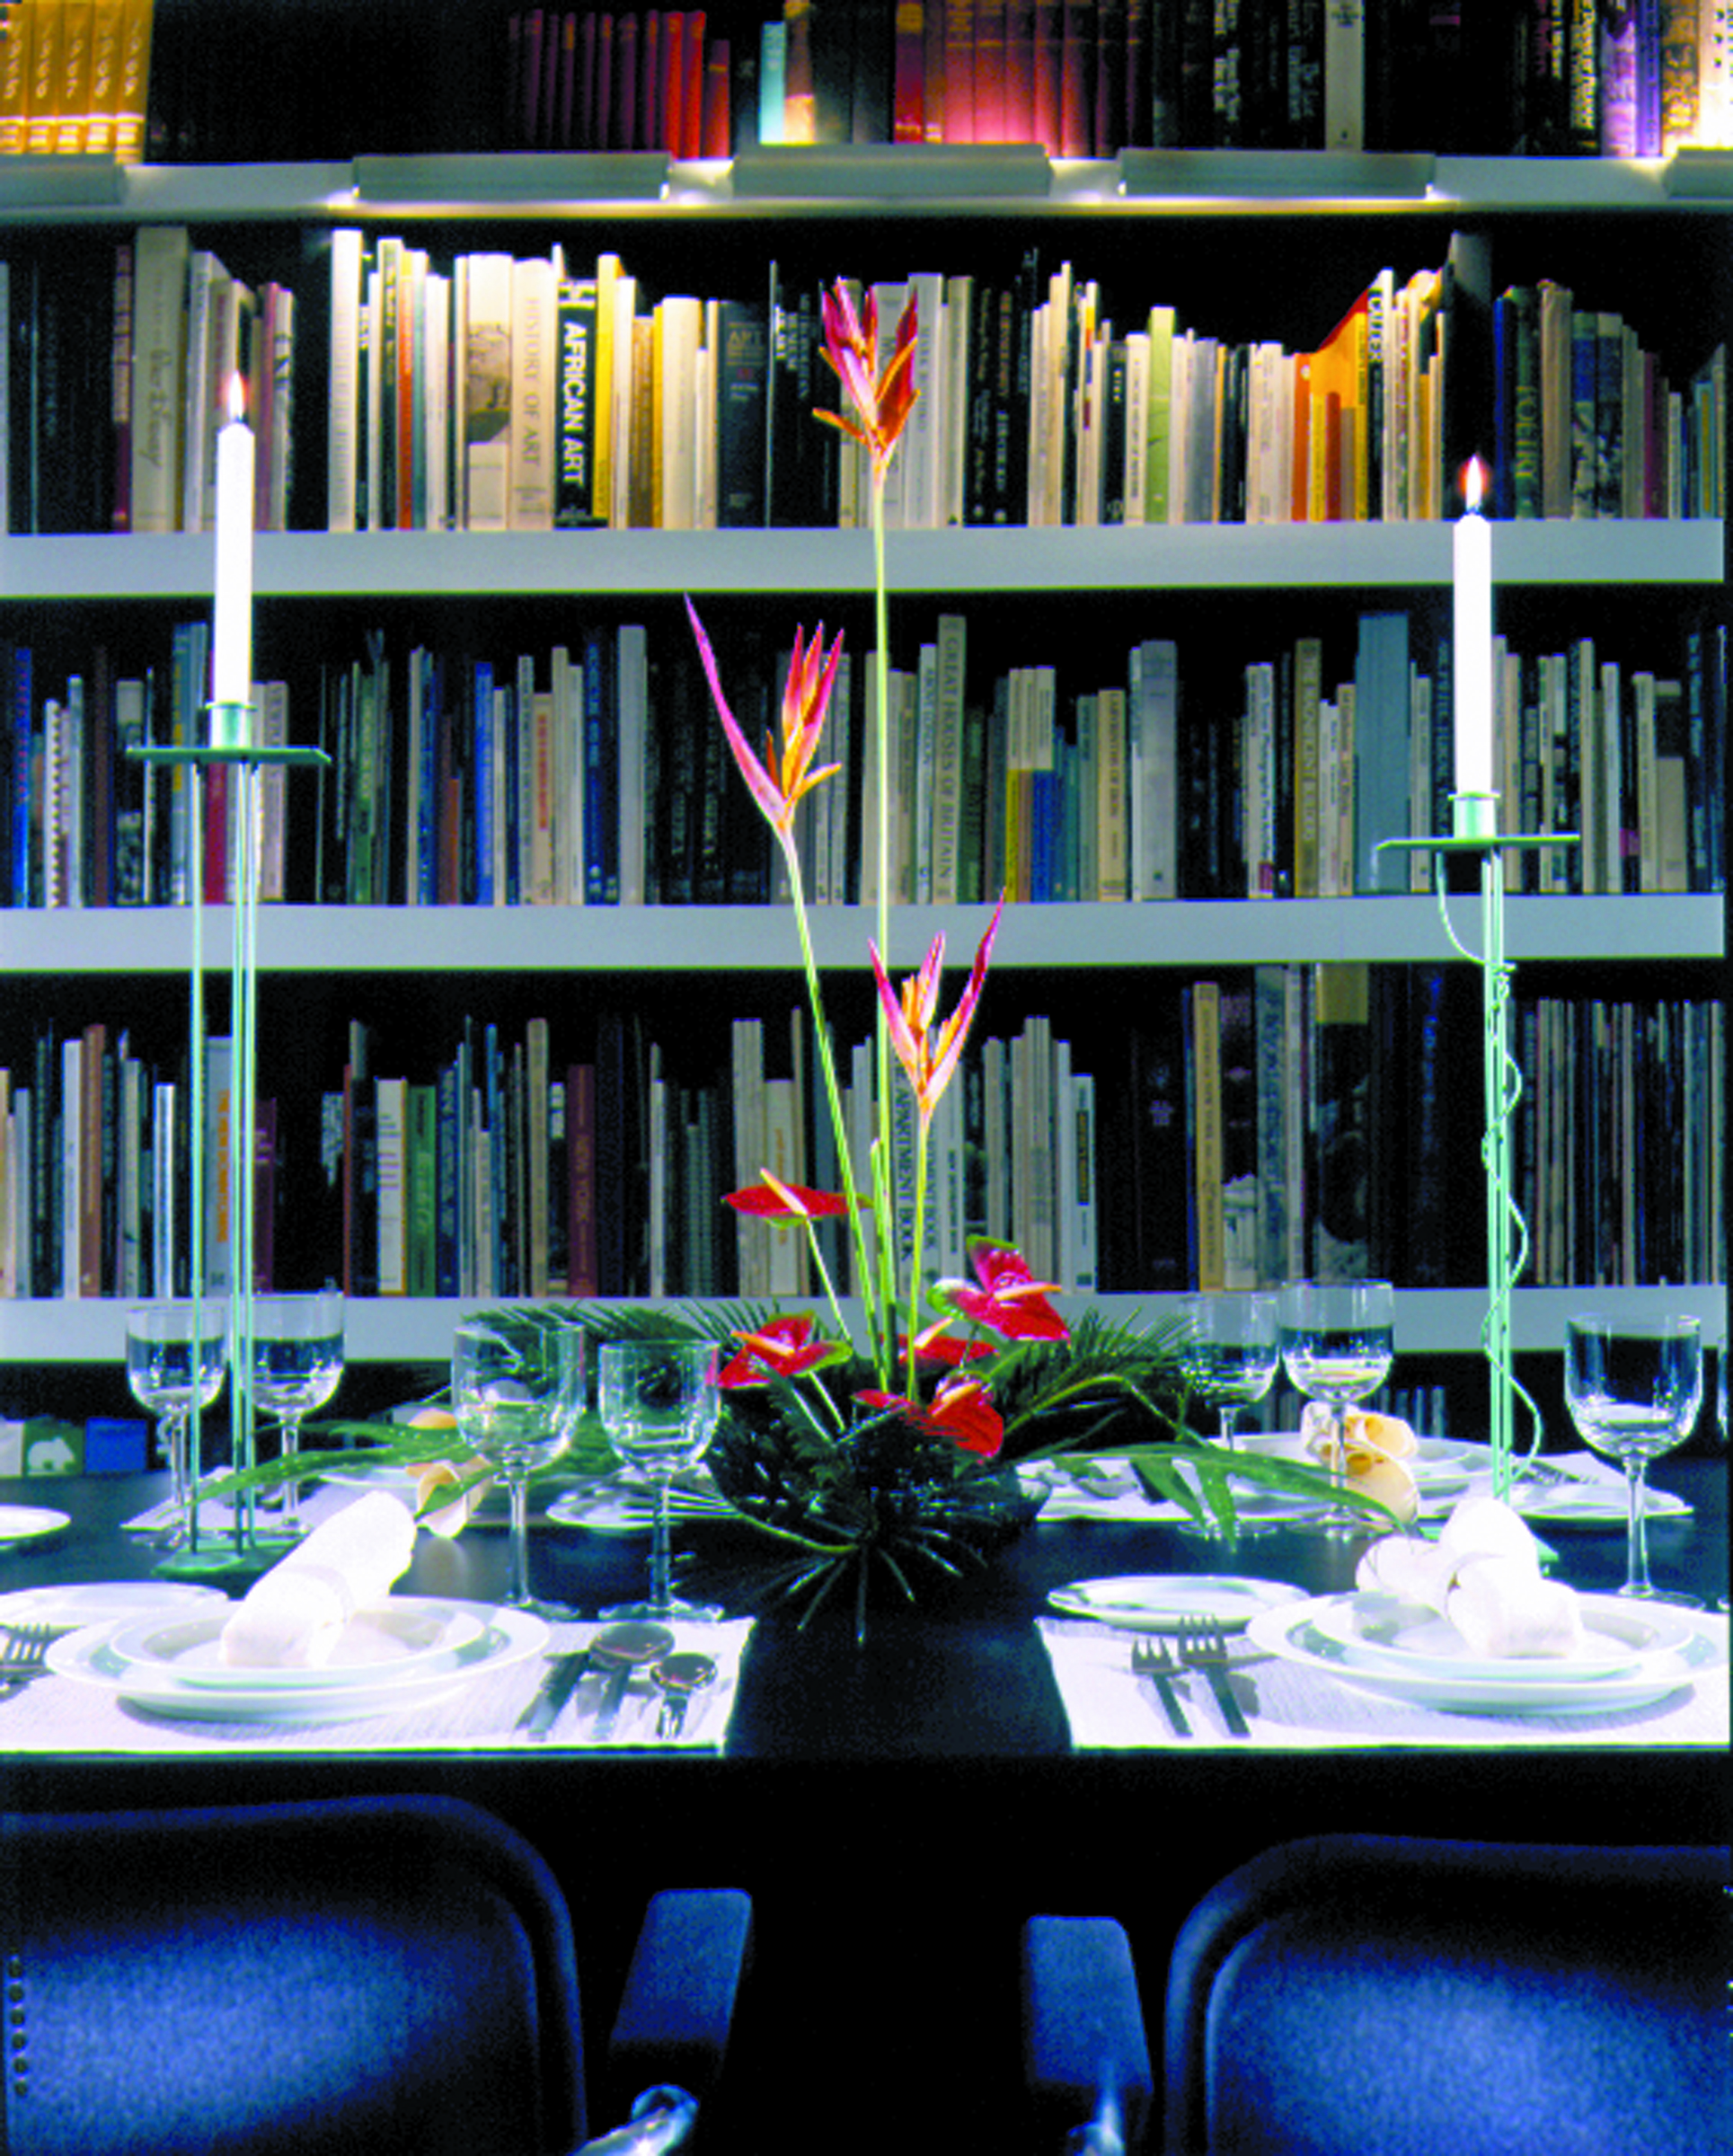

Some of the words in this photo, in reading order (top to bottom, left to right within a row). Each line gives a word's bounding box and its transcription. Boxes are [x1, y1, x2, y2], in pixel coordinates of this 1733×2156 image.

[523, 297, 540, 380] HISTORY
[563, 321, 587, 430] AFRICAN
[523, 394, 540, 418] OF
[1515, 385, 1537, 481] POETRY
[522, 426, 540, 467] ART
[563, 437, 584, 486] ART
[943, 637, 958, 694] GREAT
[1303, 656, 1315, 683] THE
[942, 701, 957, 771] HOUSES
[1303, 686, 1315, 777] MAGNIFICENT
[1437, 639, 1450, 782] ARCHITECTURAL
[942, 776, 956, 797] OF
[1303, 782, 1315, 842] BUILDERS
[939, 803, 955, 878] BRITAIN
[218, 1089, 229, 1112] THE
[217, 1118, 229, 1147] NEW
[574, 1135, 590, 1173] NEW
[894, 1087, 915, 1201] APARTMENT
[217, 1151, 229, 1243] DOWNTOWNS
[575, 1177, 590, 1223] YORK
[899, 1206, 915, 1261] BOOK
[924, 1205, 937, 1250] BOOK
